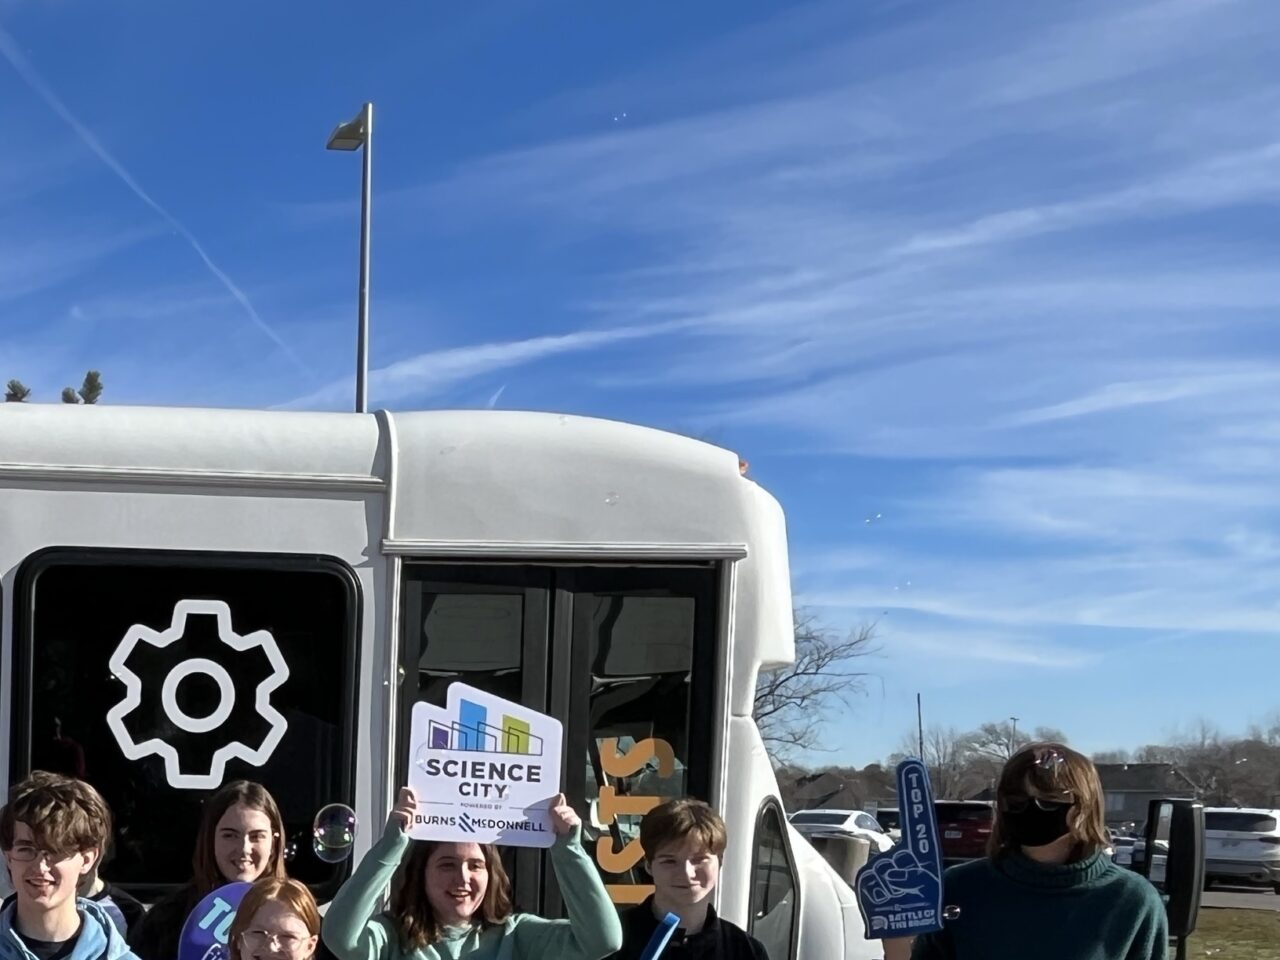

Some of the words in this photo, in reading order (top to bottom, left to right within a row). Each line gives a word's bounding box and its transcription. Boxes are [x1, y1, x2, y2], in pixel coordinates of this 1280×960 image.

[426, 758, 541, 783] SCIENCE
[459, 782, 508, 798] CITY
[908, 773, 924, 819] TOP
[415, 814, 456, 826] BURNS
[915, 824, 929, 854] 20
